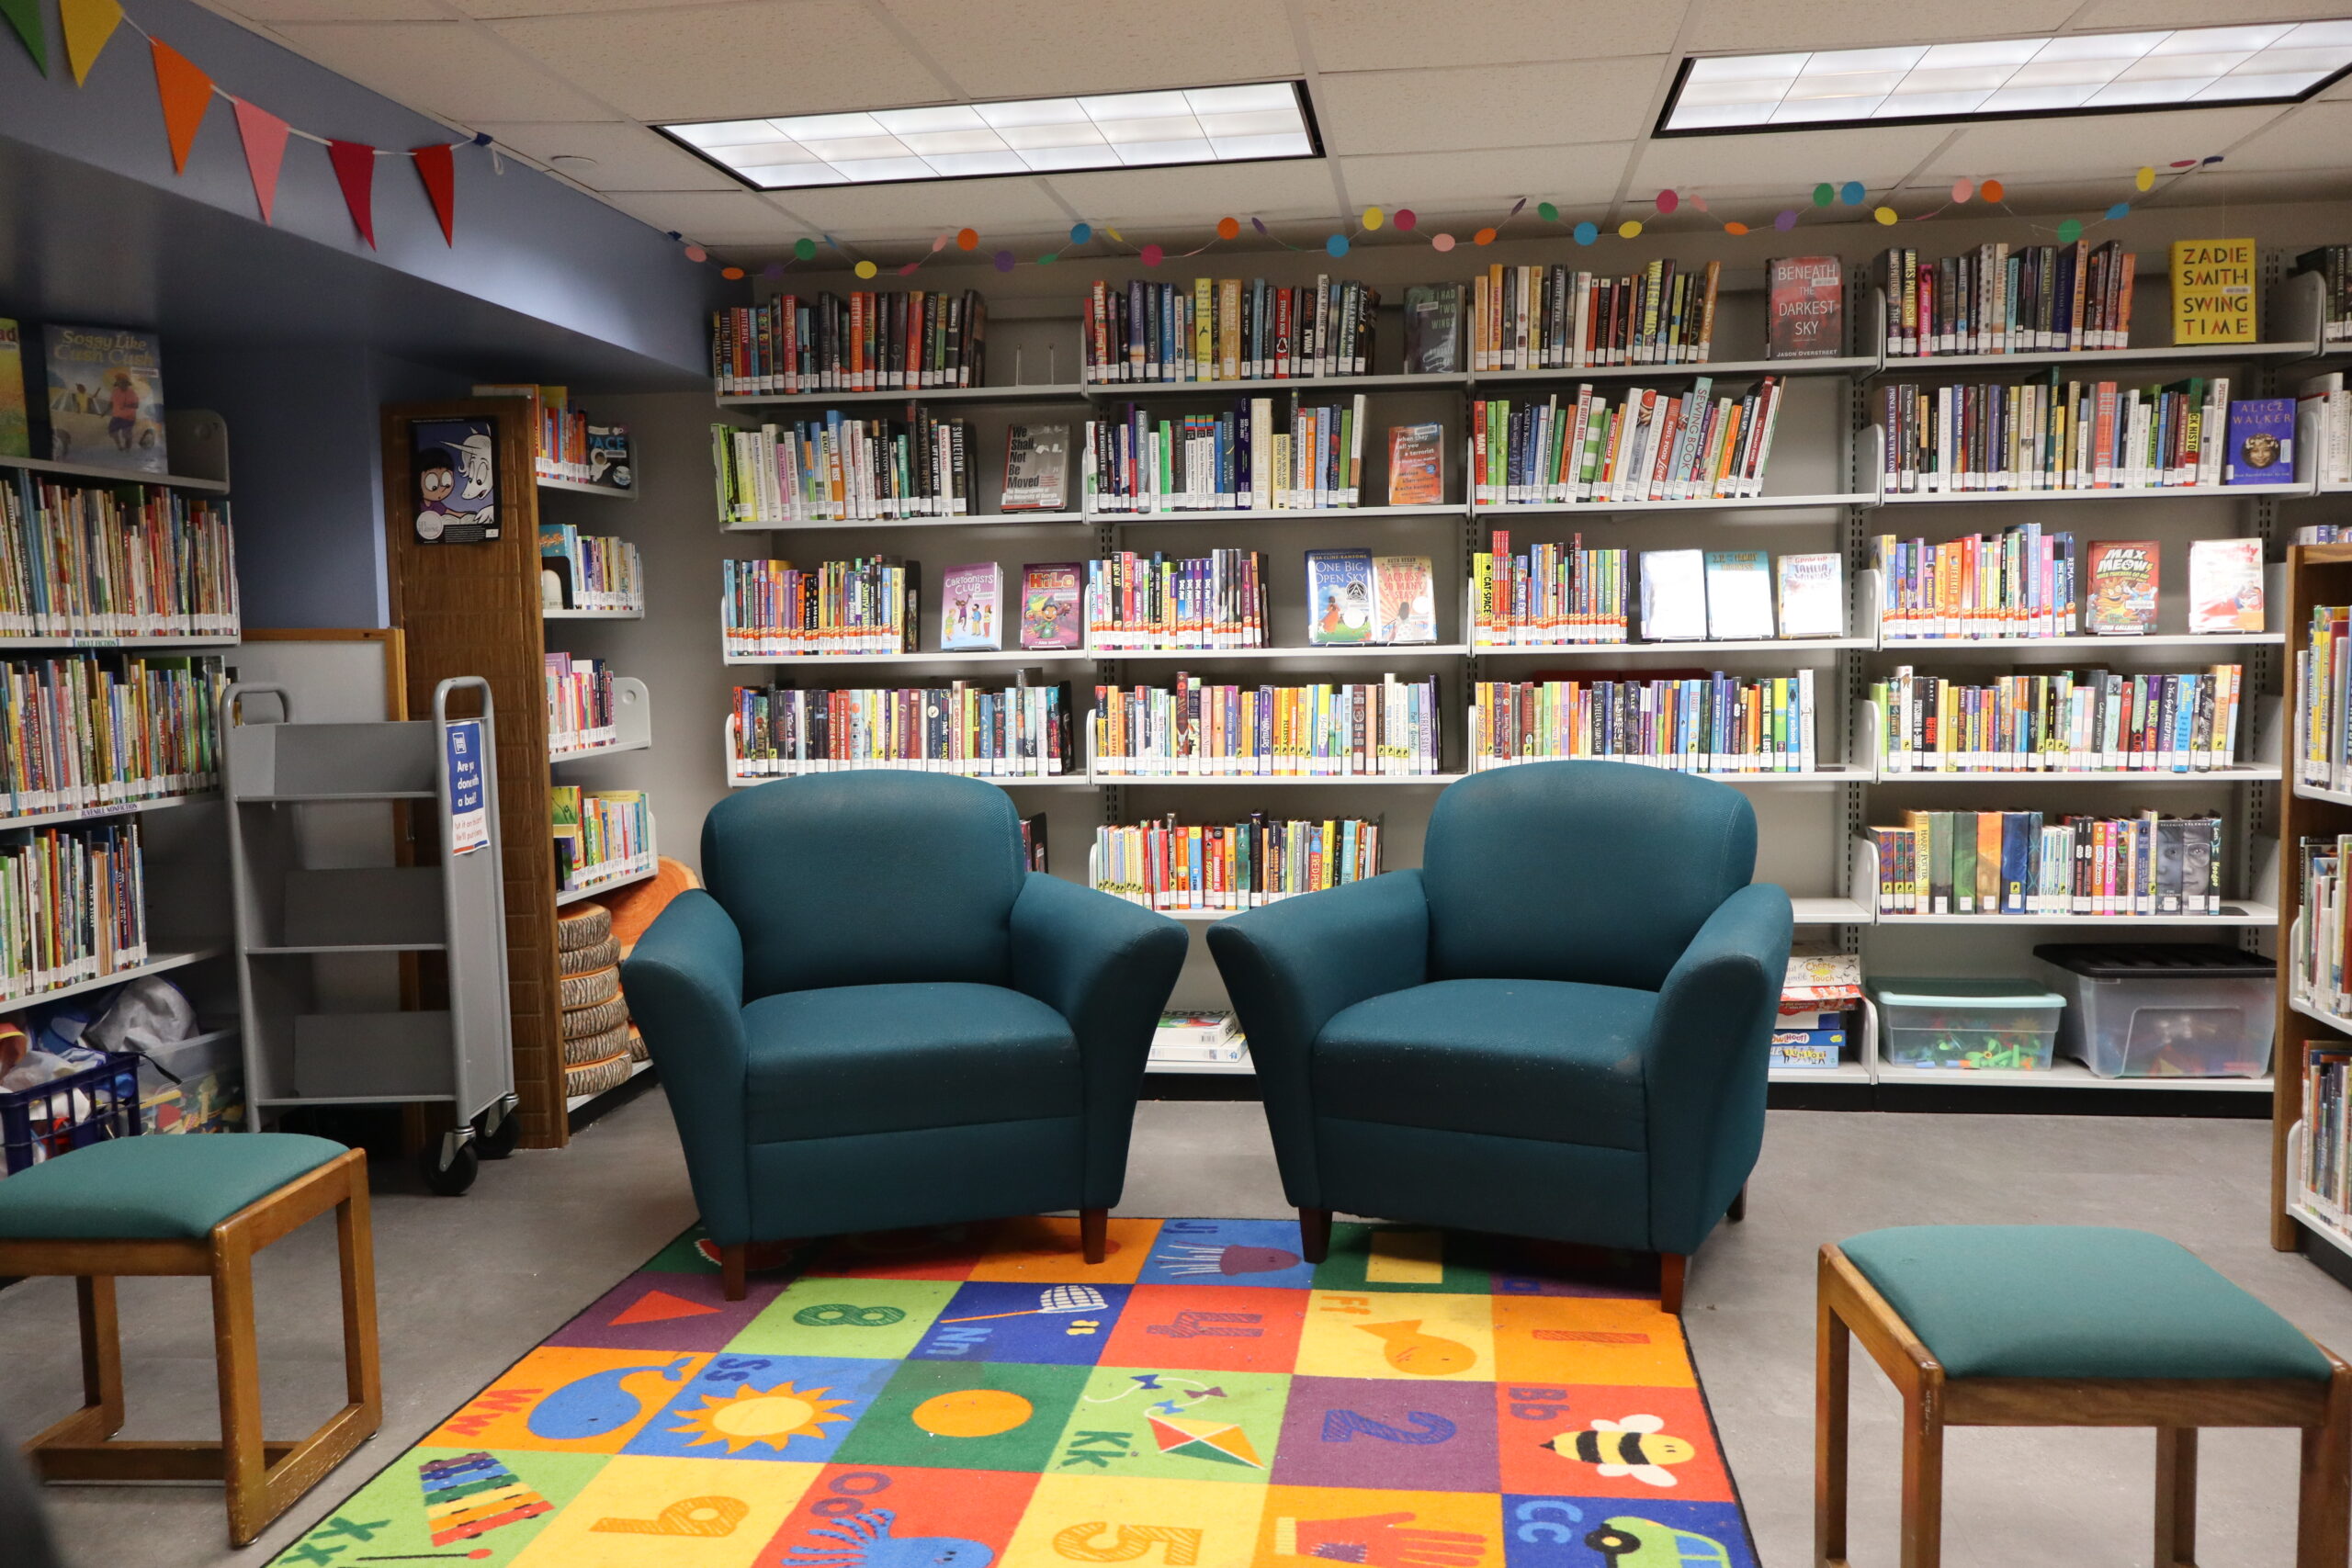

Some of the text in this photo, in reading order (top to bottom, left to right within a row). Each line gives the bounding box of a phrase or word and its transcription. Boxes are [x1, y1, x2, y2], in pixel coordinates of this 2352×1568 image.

[2183, 247, 2248, 265] ZADIE
[1778, 264, 1836, 280] BENEATH
[2183, 268, 2248, 286] SMITH
[1646, 261, 1661, 305] WALTER
[1799, 286, 1815, 296] THE
[1905, 252, 1916, 326] JAMES PATTERSON
[1441, 289, 1455, 299] HAD
[1440, 304, 1455, 314] TWO
[1779, 300, 1836, 317] DARKEST
[2183, 296, 2248, 313] SWING
[1431, 318, 1454, 329] WINGS
[1794, 321, 1819, 336] SKY
[2183, 318, 2248, 335] TIME
[62, 330, 147, 350] Soggy Like
[2099, 392, 2112, 416] BLUE
[2217, 384, 2226, 410] SPECTACLE
[1741, 398, 1753, 431] LEVEL UP
[2241, 402, 2284, 412] ALICE
[1579, 407, 1589, 425] USEFUL
[2233, 415, 2291, 424] WALKER
[1012, 426, 1027, 438] We
[1577, 427, 1585, 441] BOOK
[1681, 389, 1708, 469] SEWING BOOK
[588, 435, 627, 450] PACE
[829, 423, 838, 454] TOGETHER
[1012, 438, 1034, 450] Shall
[1415, 434, 1429, 442] they
[1477, 434, 1486, 455] MAN
[1752, 429, 1761, 448] ULTIMATE
[952, 426, 963, 472] SMOKETOWN
[1010, 451, 1026, 463] Not
[1409, 447, 1434, 456] terrorist
[1656, 420, 1674, 481] SOUL FOOD Love
[831, 456, 838, 465] WE
[1009, 464, 1021, 476] Be
[1007, 475, 1039, 489] Moved
[2105, 548, 2146, 559] MAX
[1316, 561, 1363, 572] ONE BIG
[1317, 572, 1366, 583] OPEN SKY
[1387, 572, 1419, 582] ACROSS
[1950, 565, 1958, 594] MEXIKID
[956, 583, 981, 594] CLUB
[1385, 581, 1422, 591] SO MANY
[1396, 591, 1413, 599] SEAS
[1478, 705, 1485, 716] We
[1914, 699, 1922, 749] PRISONER B-3087
[1926, 716, 1936, 744] REFUGEE
[457, 761, 469, 773] Are
[81, 803, 138, 818] JUVENILE NONFICTION
[1920, 829, 1928, 880] HARRY POTTER
[1310, 859, 1319, 891] RED PENC
[1805, 960, 1836, 972] Cheese
[1161, 1220, 1219, 1237] Jj
[1318, 1295, 1371, 1315] Ff
[793, 1303, 906, 1326] 8
[1147, 1311, 1264, 1338] 4
[925, 1325, 993, 1356] Nn
[705, 1358, 773, 1382] Ss
[1508, 1386, 1570, 1421] Bb
[1321, 1408, 1457, 1446] 2
[1061, 1429, 1125, 1471] Kk
[810, 1472, 894, 1518] Oo
[1516, 1499, 1583, 1544] Cc
[277, 1517, 391, 1566] Xx
[1052, 1521, 1203, 1567] 5
